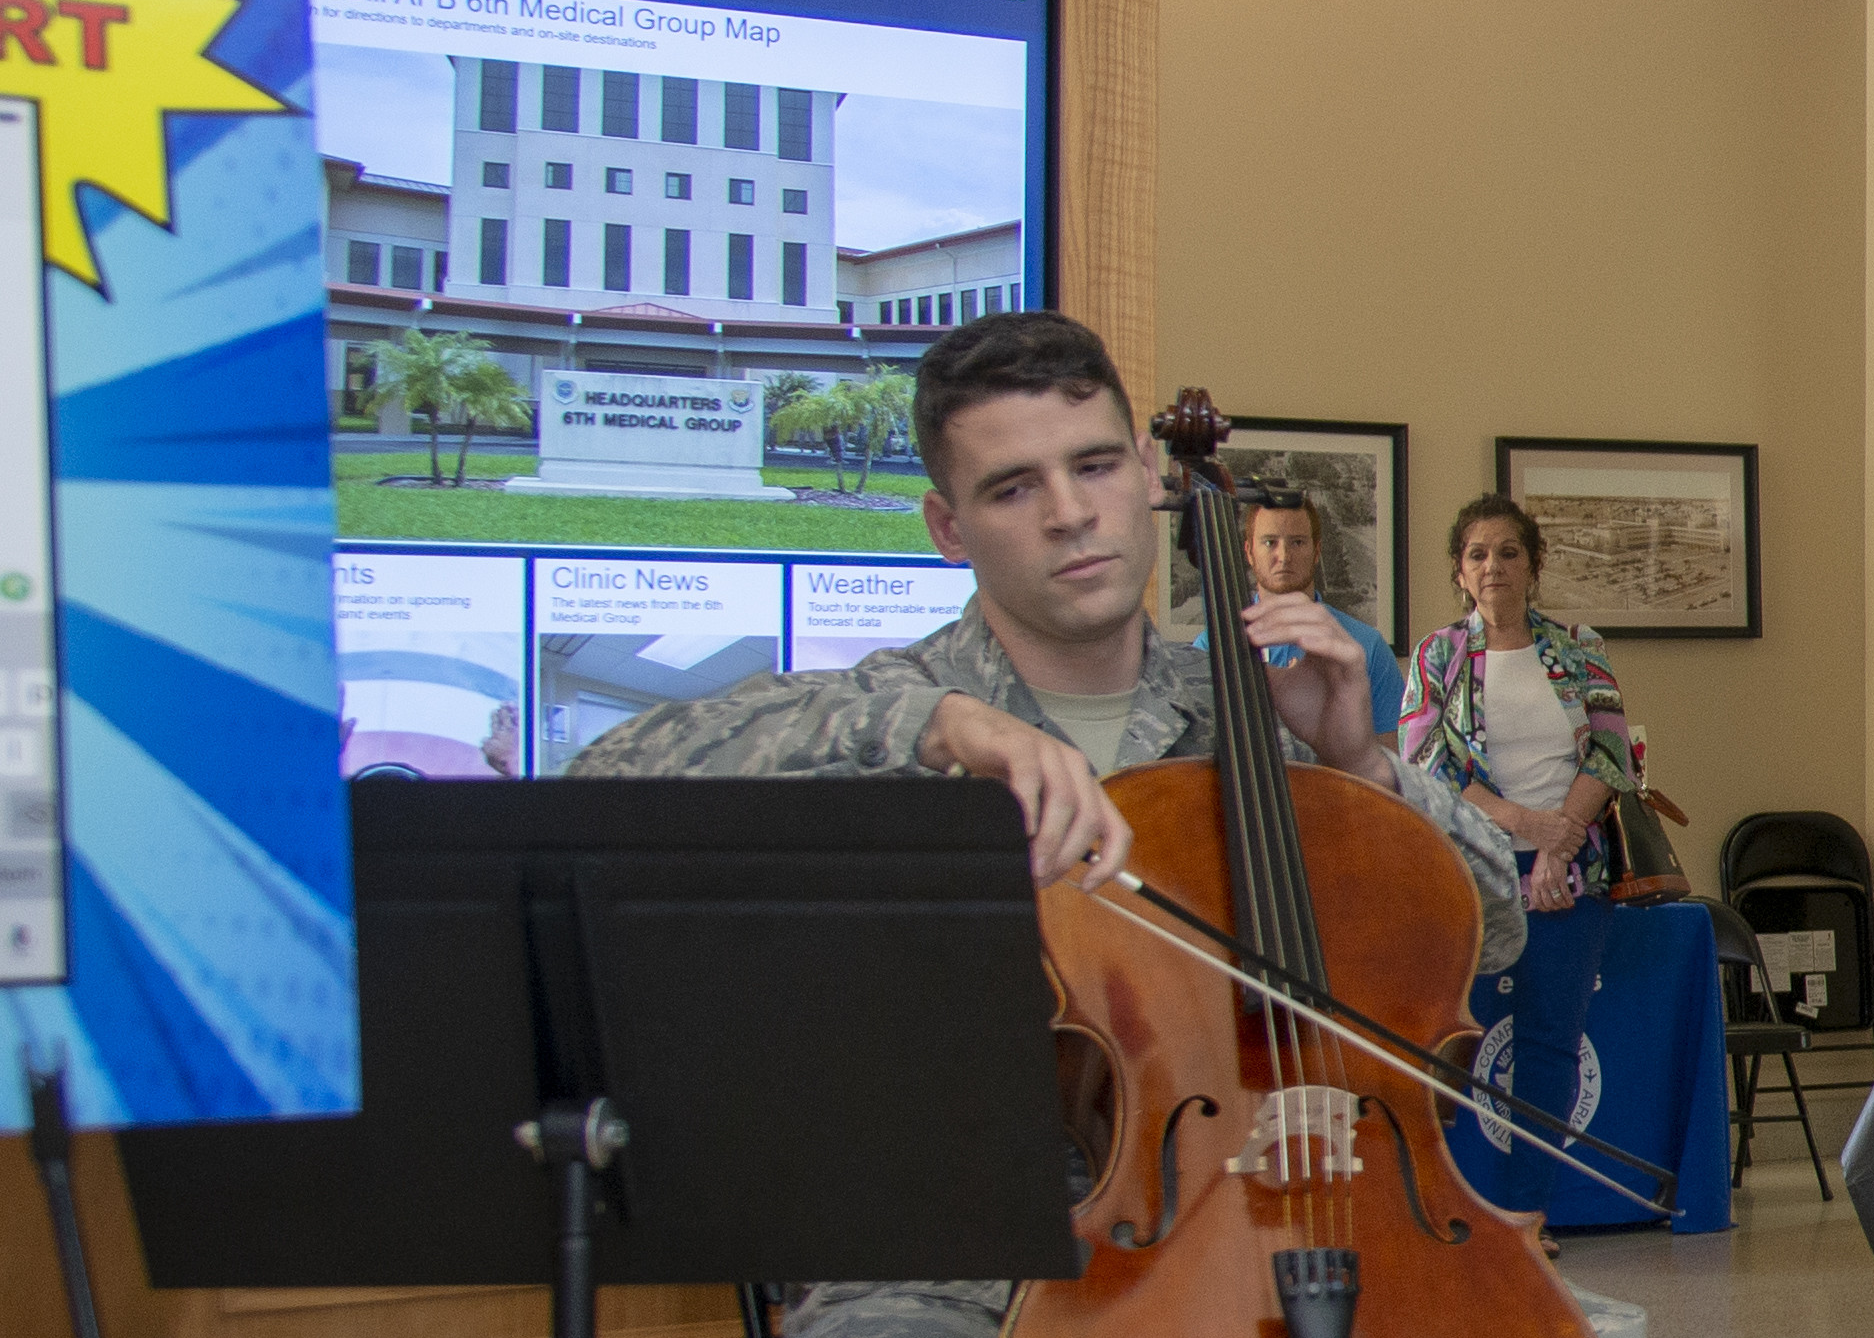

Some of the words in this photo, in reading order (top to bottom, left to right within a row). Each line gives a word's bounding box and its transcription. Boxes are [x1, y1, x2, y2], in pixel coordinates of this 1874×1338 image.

[323, 5, 340, 19] for
[344, 7, 409, 27] directions
[411, 16, 424, 27] to
[427, 18, 508, 38] departments
[511, 23, 535, 39] and
[537, 27, 580, 44] on-site
[584, 31, 658, 51] destinations
[634, 7, 716, 42] Group
[725, 16, 781, 48] Map
[583, 390, 722, 412] HEADQUARTERS
[562, 411, 596, 426] 6TH
[603, 412, 680, 430] MEDICAL
[685, 417, 743, 432] GROUP
[551, 566, 627, 590] Clinic
[634, 568, 709, 592] News
[807, 572, 915, 596] Weather
[387, 595, 404, 606] on
[407, 595, 472, 610] upcoming
[551, 596, 576, 609] The
[579, 597, 613, 609] latest
[614, 599, 648, 610] news
[650, 598, 679, 610] from
[681, 599, 702, 611] the
[704, 599, 723, 611] 6th
[807, 601, 843, 613] Touch
[845, 601, 862, 613] for
[863, 602, 926, 615] searchable
[928, 604, 964, 615] weath
[367, 610, 412, 621] events
[550, 612, 599, 624] Medical
[602, 613, 642, 626] Group
[806, 615, 854, 628] forecast
[856, 616, 882, 628] data
